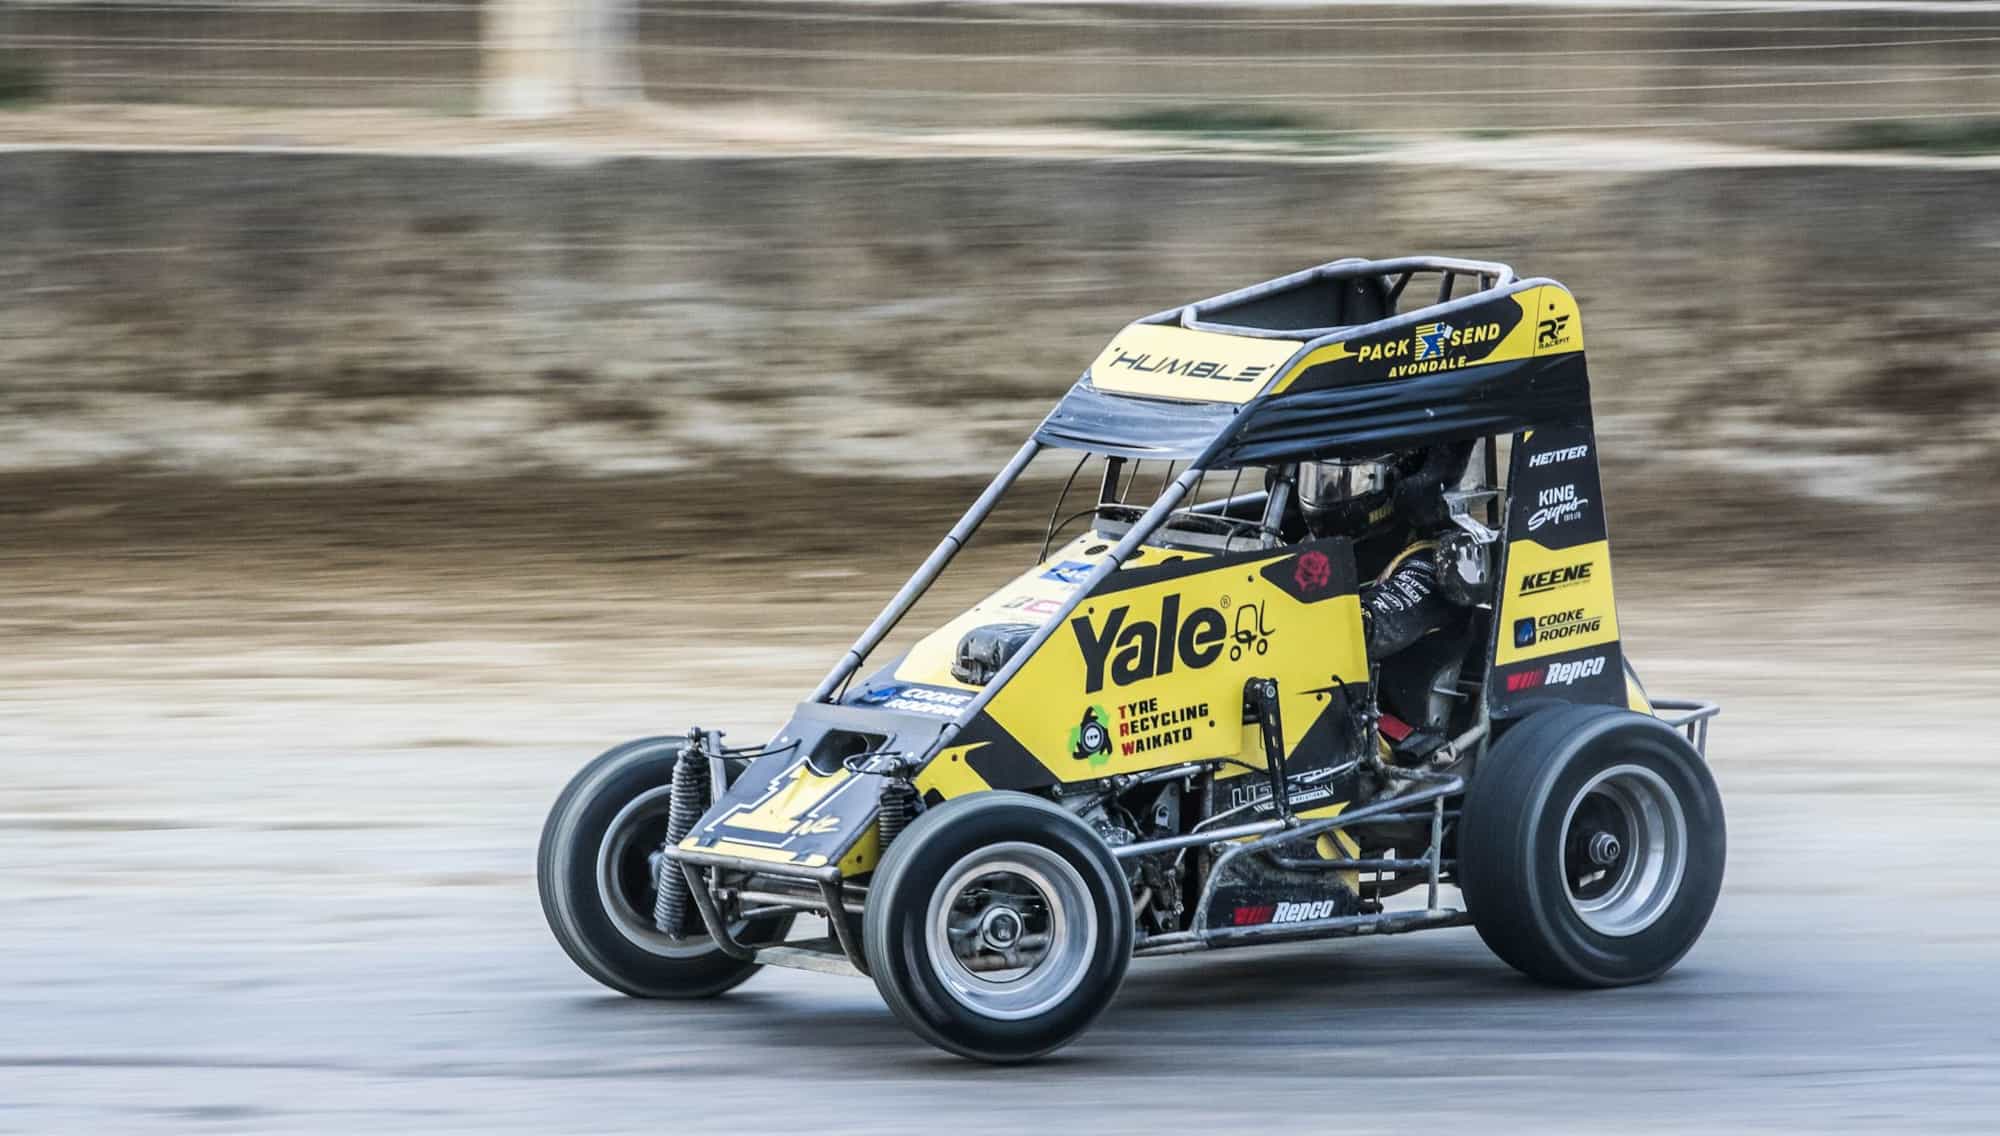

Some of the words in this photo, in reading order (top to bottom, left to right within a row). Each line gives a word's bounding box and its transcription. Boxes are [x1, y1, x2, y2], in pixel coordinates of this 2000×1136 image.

[1358, 338, 1410, 363] PACK
[1450, 322, 1501, 347] SEND
[1109, 350, 1268, 383] HUMBLE
[1388, 355, 1467, 378] AVONDALE
[1528, 445, 1589, 468] HEATER
[1538, 484, 1575, 507] KING
[1527, 496, 1589, 532] Signs
[1520, 561, 1594, 592] KEENE
[1538, 608, 1585, 628] COOKE
[1539, 619, 1601, 643] ROOFING
[1071, 592, 1227, 695] Yale
[1544, 656, 1606, 686] Repco
[1117, 697, 1158, 719] TYRE
[1119, 703, 1209, 737] RECYCLING
[1121, 726, 1193, 757] WAIKATO
[1271, 900, 1335, 924] Repco
